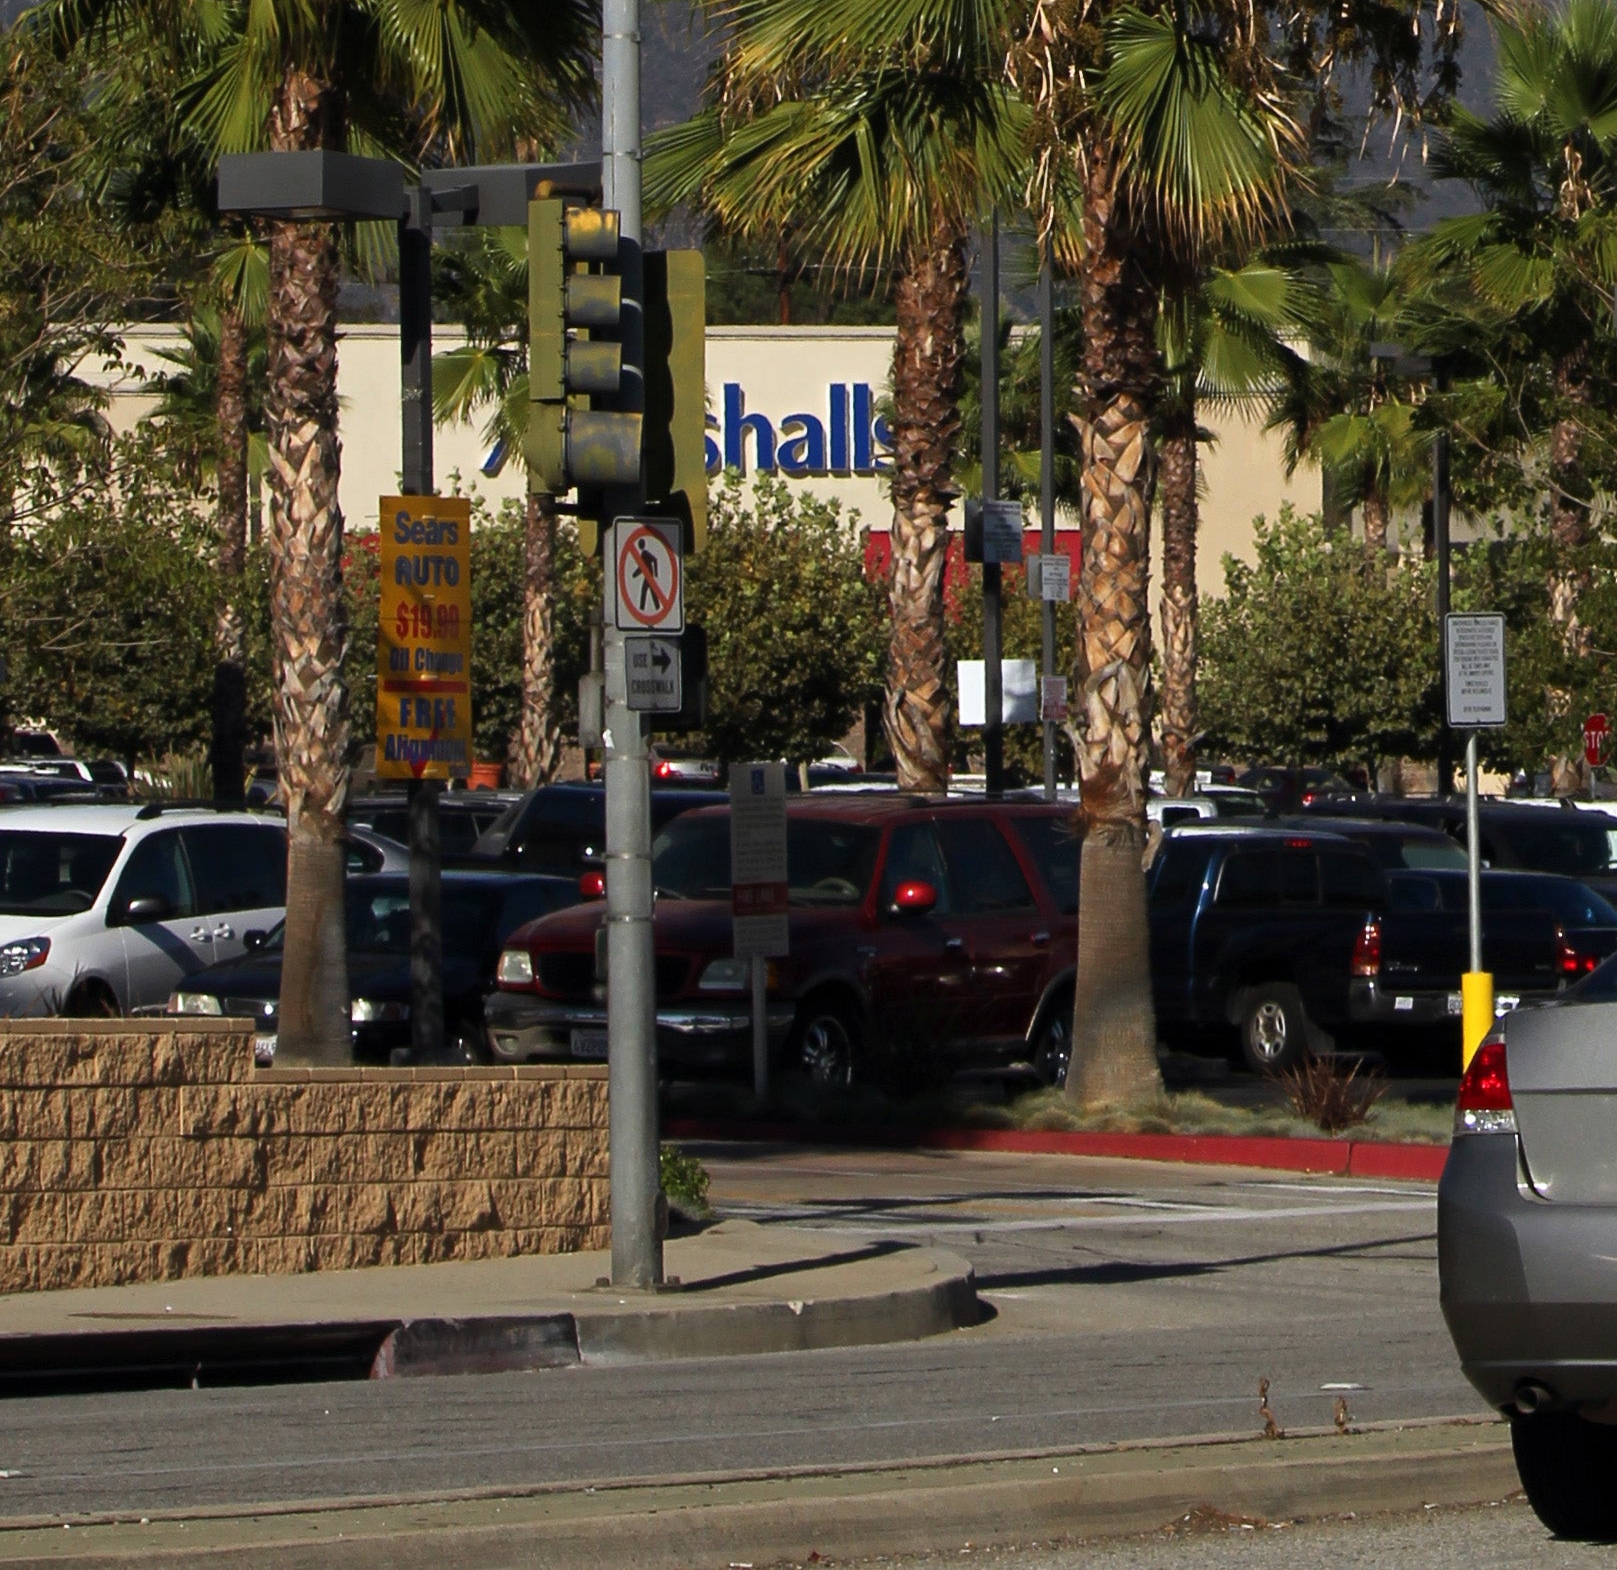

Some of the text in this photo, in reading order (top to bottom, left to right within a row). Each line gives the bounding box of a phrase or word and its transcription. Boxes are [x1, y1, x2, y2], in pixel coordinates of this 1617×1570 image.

[394, 511, 458, 545] Sears
[395, 555, 458, 587] AUTO
[400, 698, 455, 729] FREE
